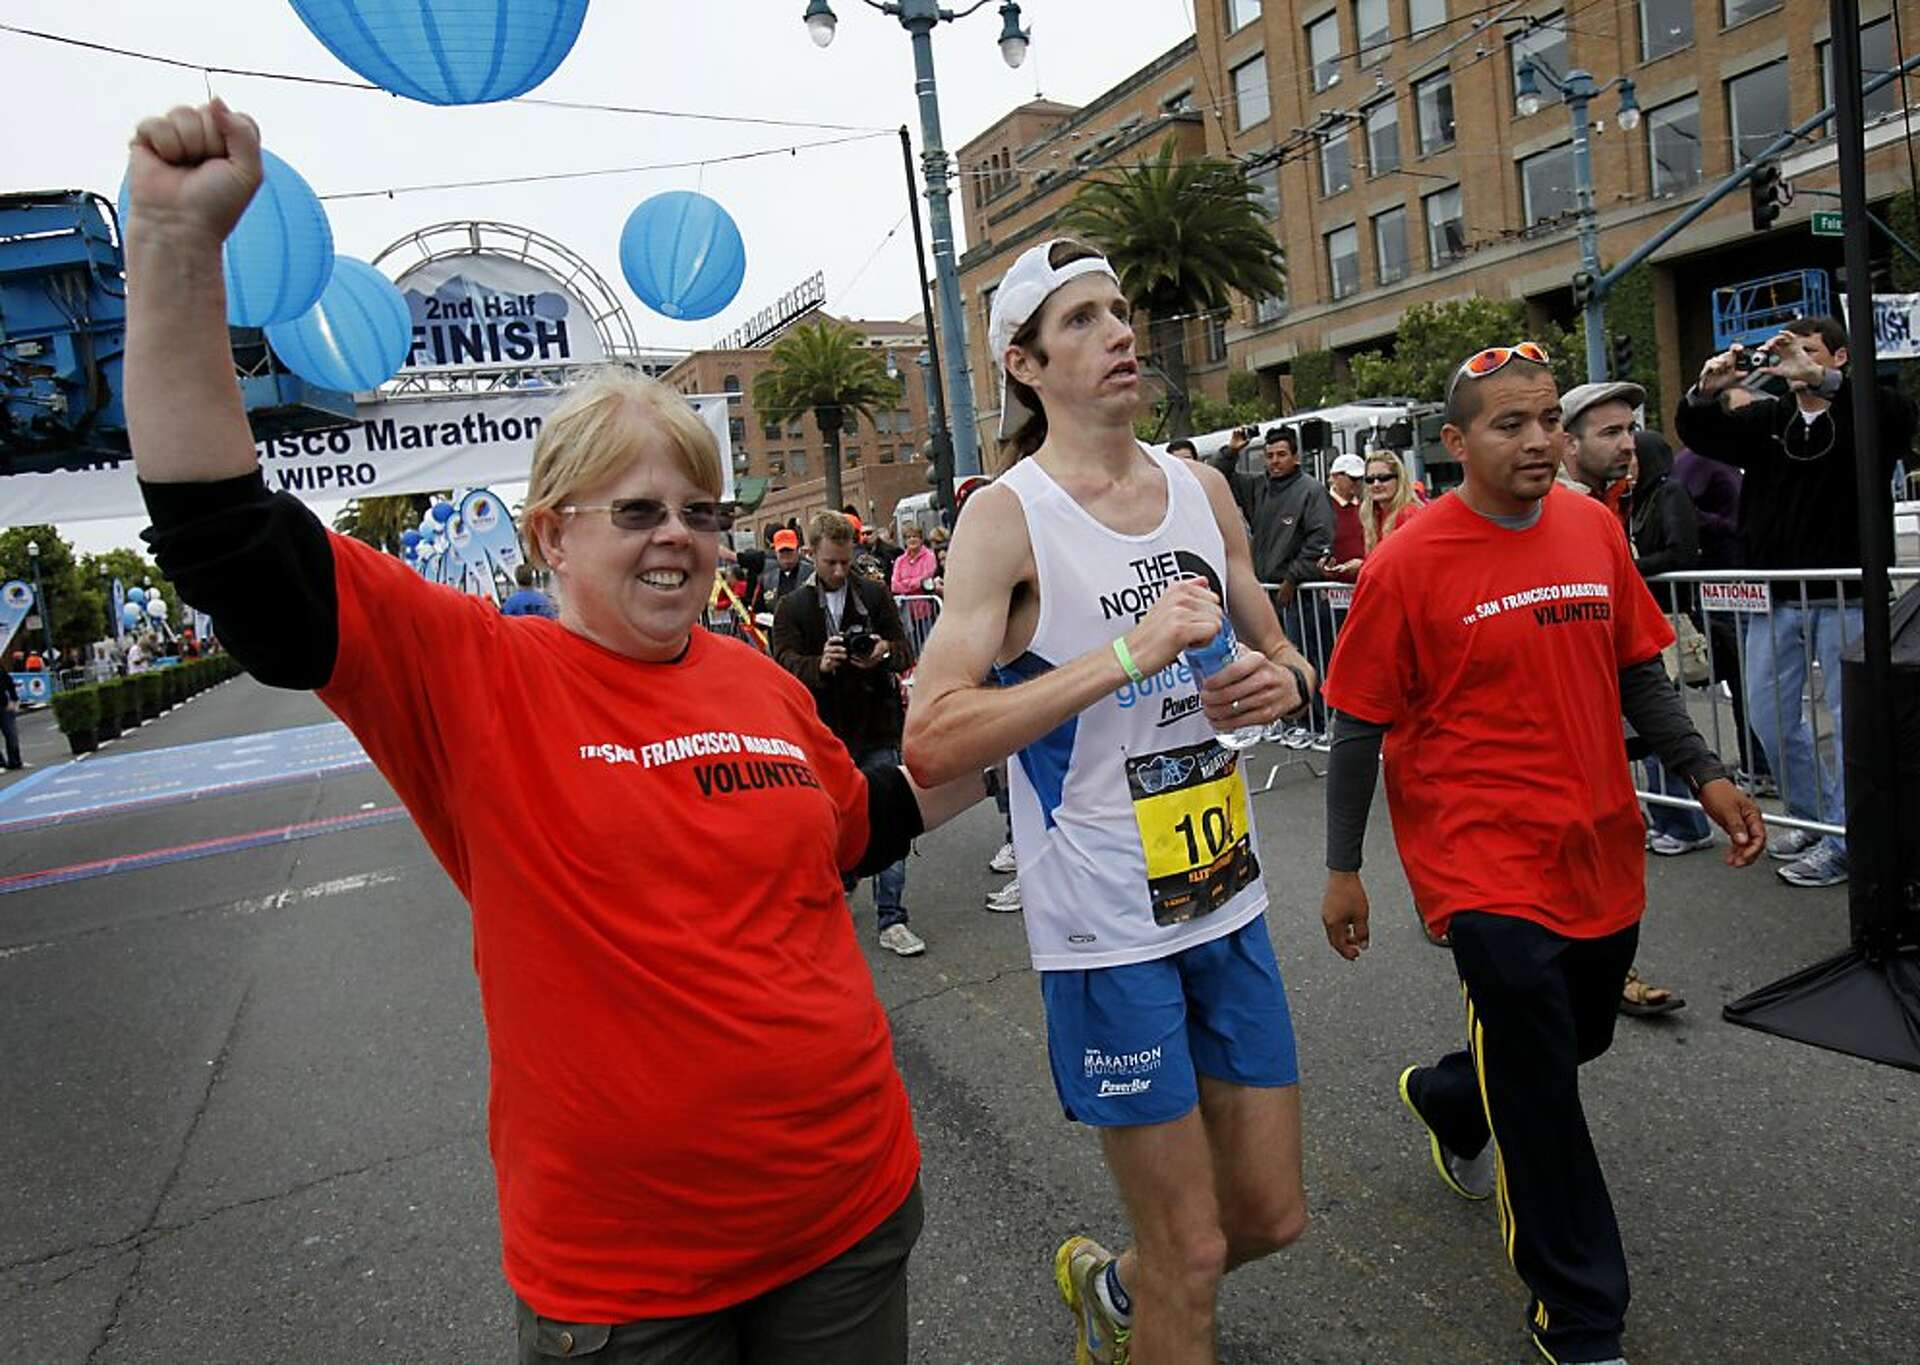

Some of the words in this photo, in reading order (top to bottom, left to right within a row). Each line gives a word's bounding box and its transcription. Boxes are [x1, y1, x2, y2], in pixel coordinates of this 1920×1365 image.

[426, 298, 474, 320] 2nd
[484, 294, 537, 318] Half
[405, 320, 570, 368] FINISH
[364, 411, 543, 452] Marathon
[277, 462, 377, 492] WIPRO
[1129, 551, 1178, 583] THE
[1099, 576, 1181, 620] NORT
[1475, 600, 1500, 619] SAN
[1501, 584, 1560, 611] FRANCISCO
[1702, 585, 1766, 600] NATIONAL
[640, 732, 741, 769] FRANCISCO
[1084, 1046, 1162, 1068] MARATHON
